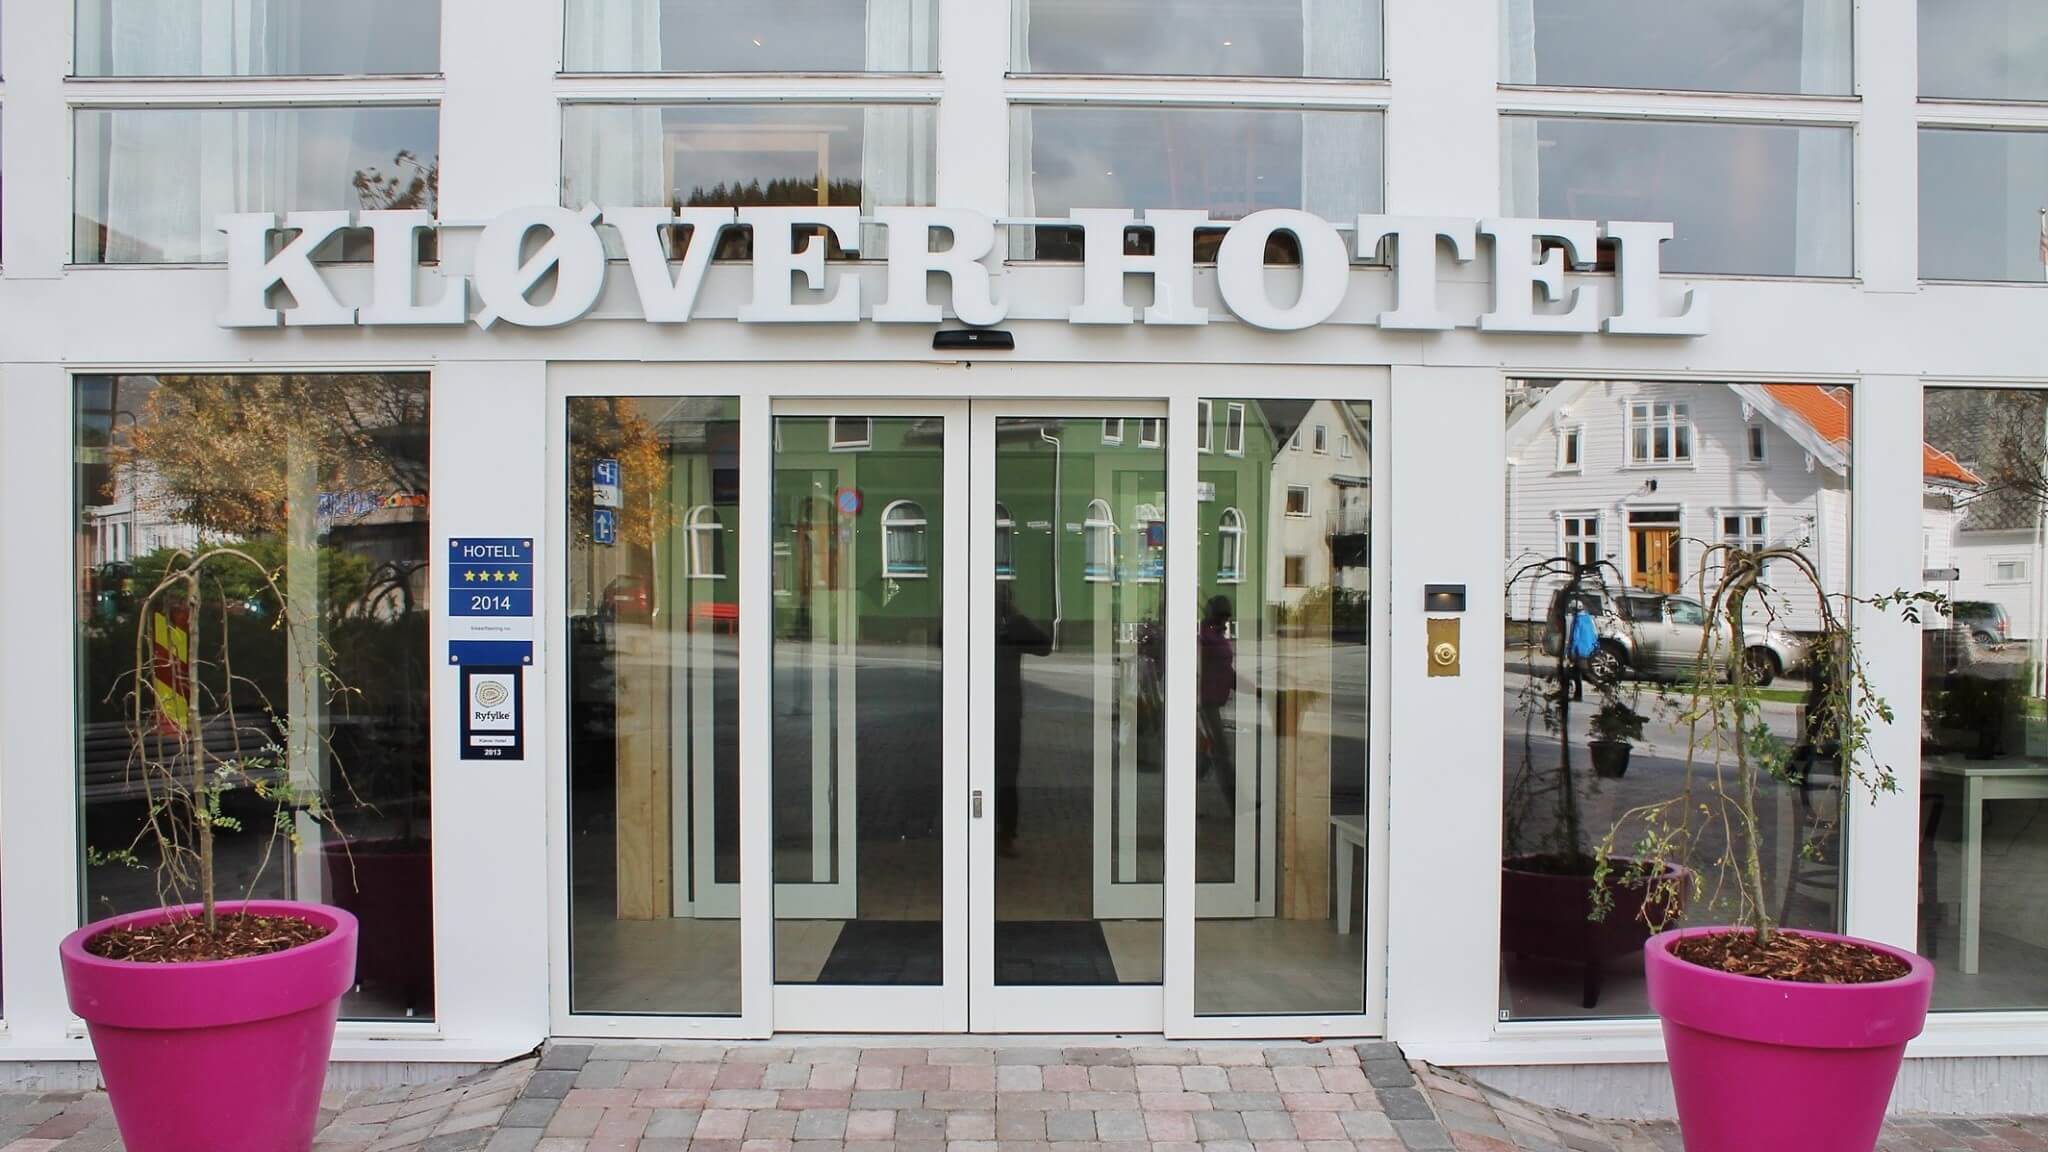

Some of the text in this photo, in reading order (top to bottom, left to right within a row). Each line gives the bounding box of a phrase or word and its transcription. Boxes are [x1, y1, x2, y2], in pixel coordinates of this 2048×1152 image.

[216, 203, 1708, 337] KLØVER HOTEL
[463, 545, 520, 557] HOTELL
[471, 595, 511, 610] 2014
[475, 711, 511, 722] Ryfylke
